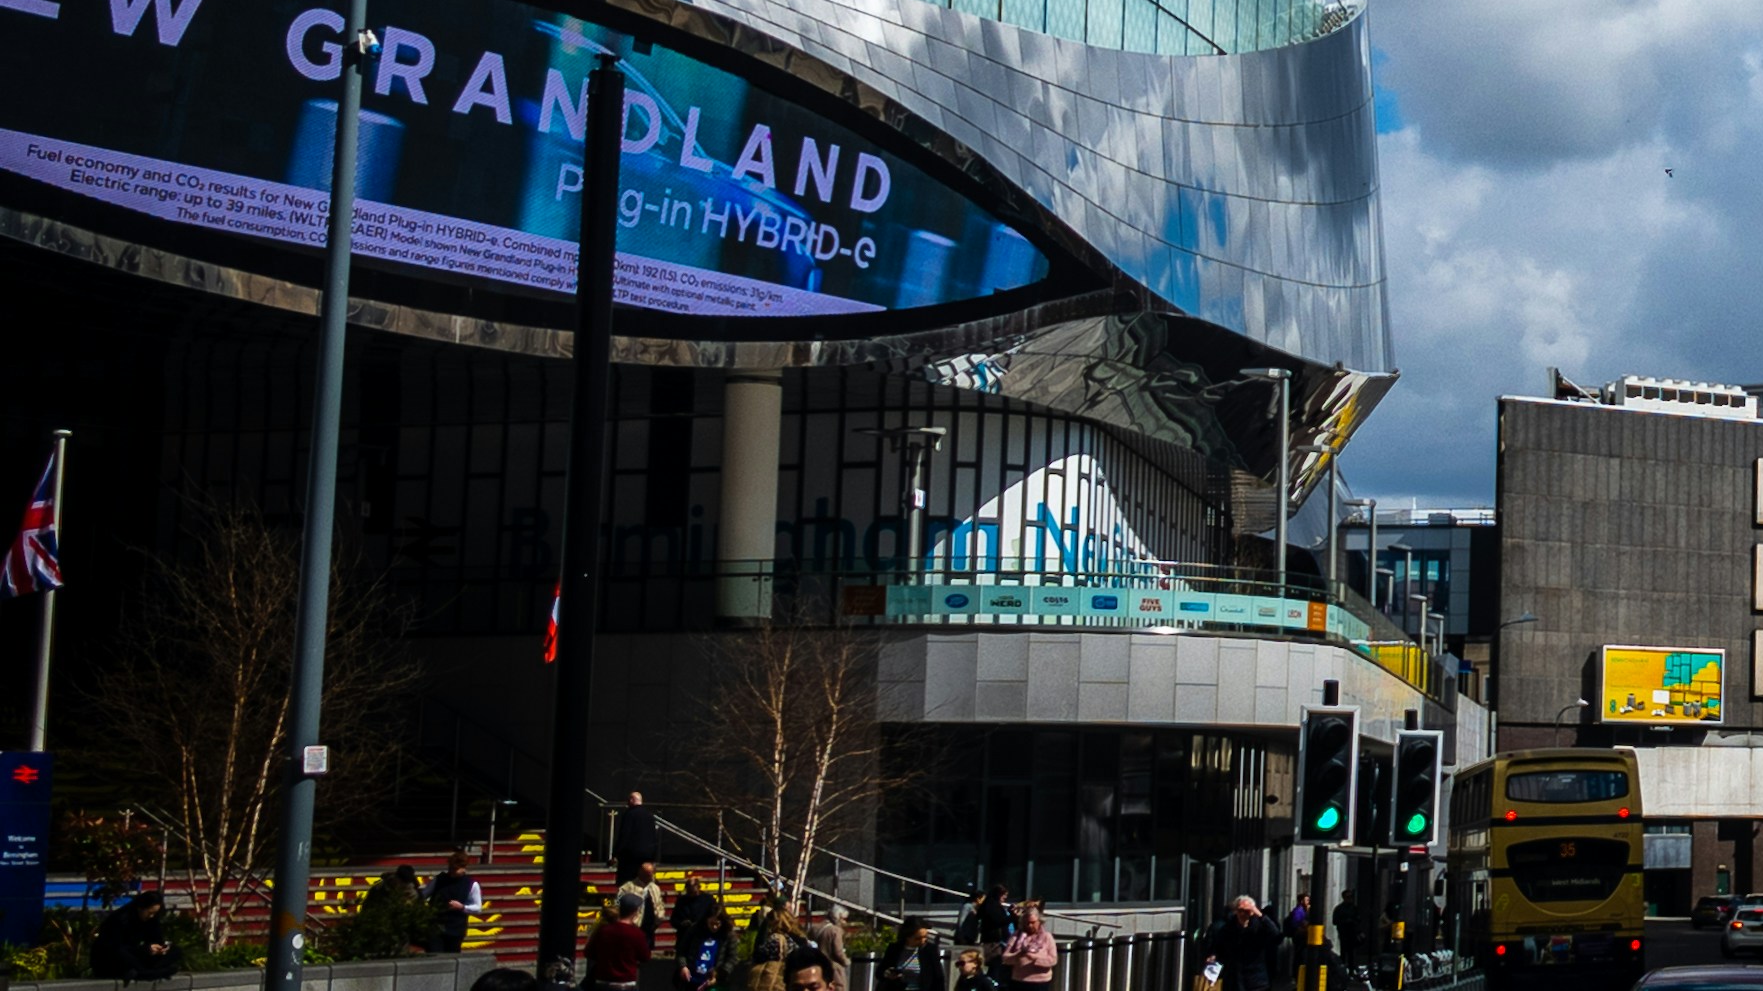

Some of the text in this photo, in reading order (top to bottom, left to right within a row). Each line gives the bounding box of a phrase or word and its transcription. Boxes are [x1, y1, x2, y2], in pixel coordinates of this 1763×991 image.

[286, 8, 891, 214] GRANDLAND
[27, 144, 62, 162] Fuel
[65, 155, 139, 180] economy
[142, 170, 172, 183] and
[208, 182, 256, 200] results
[260, 189, 279, 204] for
[283, 194, 315, 211] New
[389, 214, 433, 234] Plug-in
[502, 237, 562, 260] Combined
[71, 169, 131, 193] Electric
[133, 183, 181, 203] range:
[184, 193, 203, 207] up
[207, 196, 222, 209] to
[226, 199, 244, 213] 39
[460, 245, 481, 258] New
[177, 207, 199, 221] The
[202, 211, 225, 225] fuel
[389, 246, 411, 258] and
[555, 163, 876, 269] Pg-in HYBRID-e
[1559, 842, 1577, 859] 35
